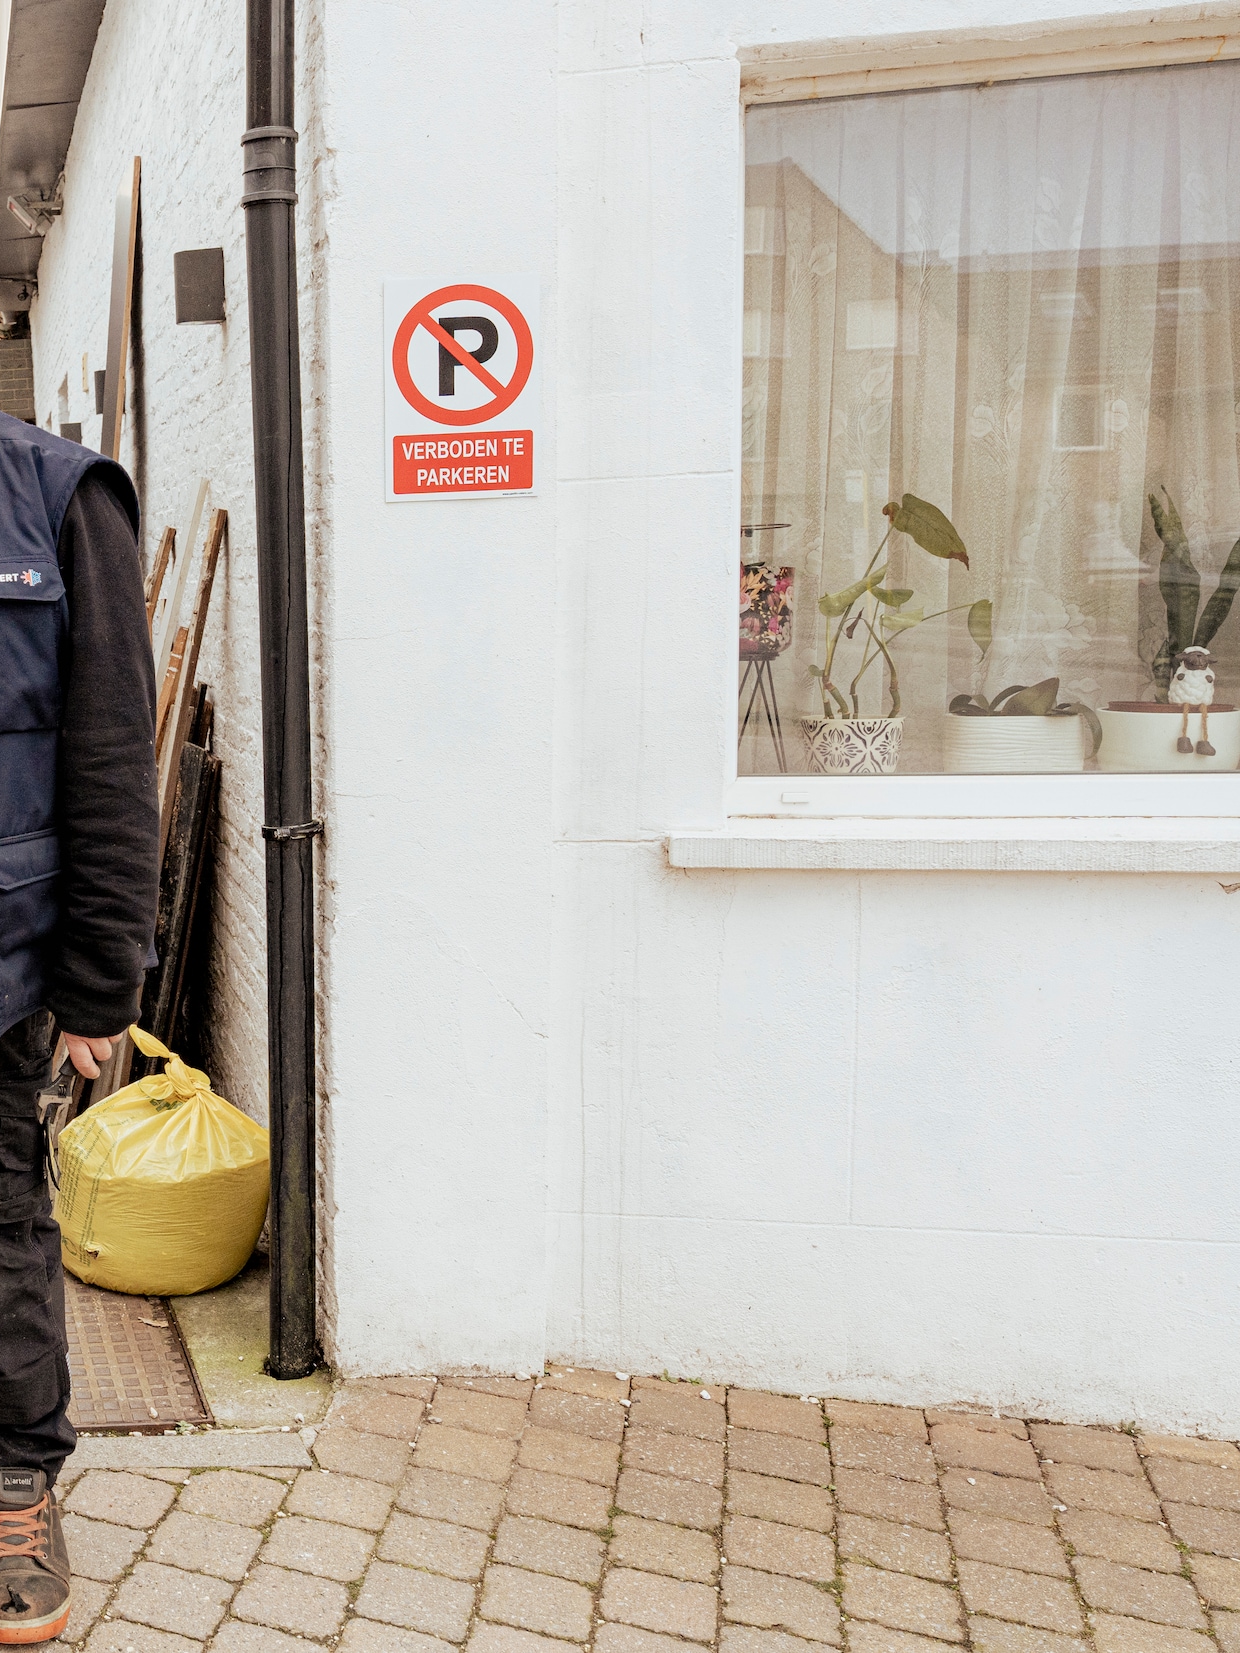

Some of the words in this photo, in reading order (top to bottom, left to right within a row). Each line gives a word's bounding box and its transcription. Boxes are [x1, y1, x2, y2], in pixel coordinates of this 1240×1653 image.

[402, 439, 498, 460] VERBODEN
[502, 438, 524, 456] TE
[417, 465, 509, 487] PARKEREN
